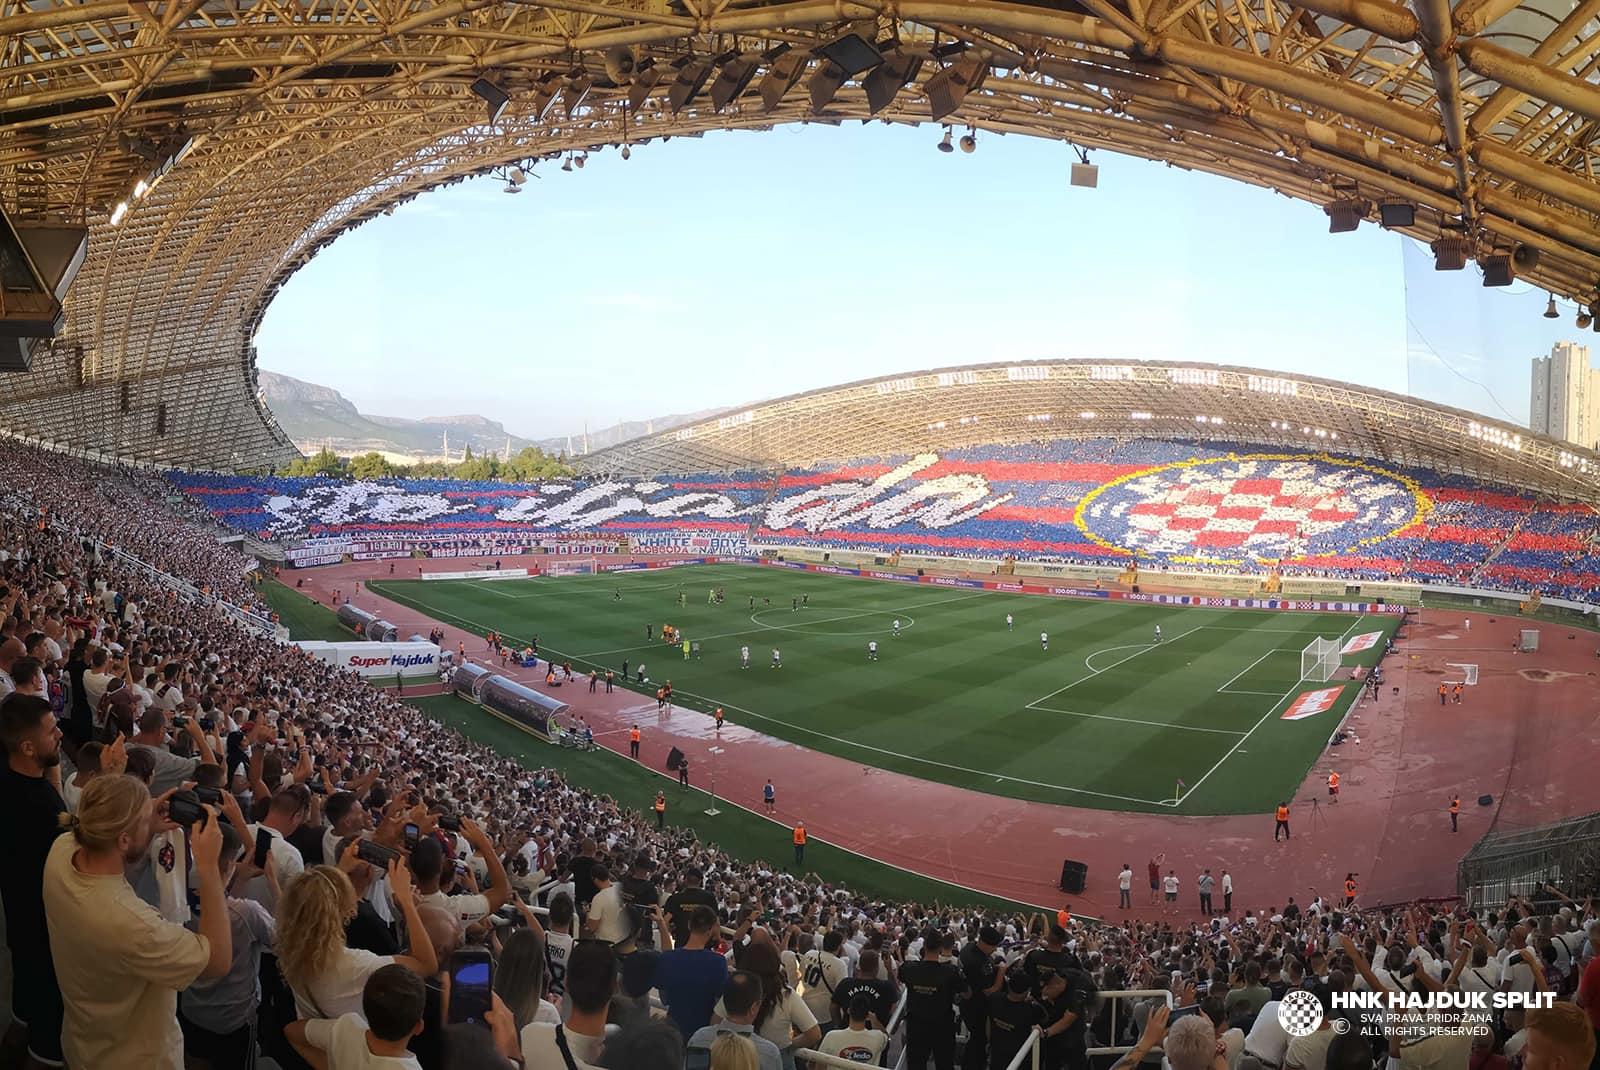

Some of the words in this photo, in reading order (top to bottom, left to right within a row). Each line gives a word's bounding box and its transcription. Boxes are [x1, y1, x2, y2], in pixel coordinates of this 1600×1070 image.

[495, 538, 542, 547] SPLIT
[637, 537, 691, 546] WHITE
[711, 538, 747, 547] BOYS
[548, 546, 615, 554] HAJDUK
[348, 655, 390, 668] Super
[391, 653, 435, 667] Hajduk
[847, 984, 881, 1000] HAJDUK
